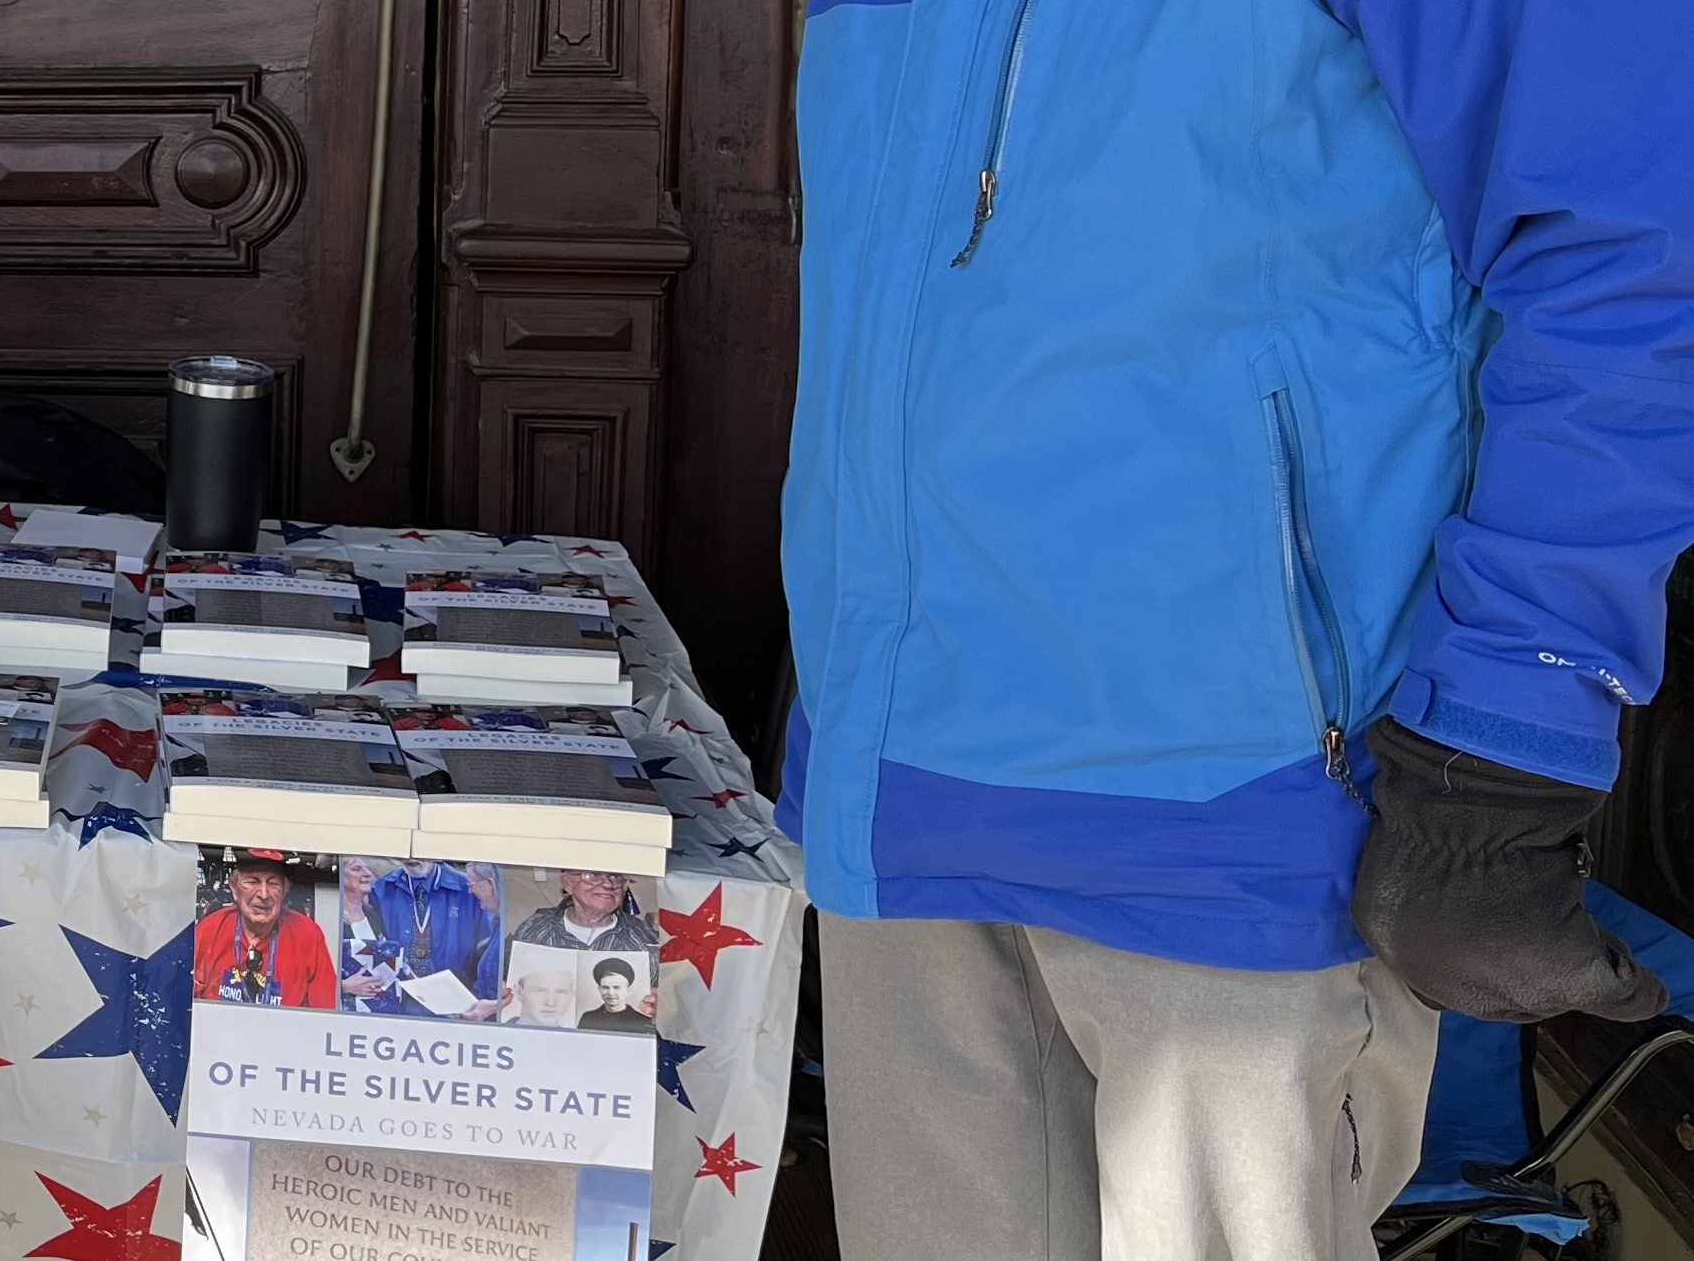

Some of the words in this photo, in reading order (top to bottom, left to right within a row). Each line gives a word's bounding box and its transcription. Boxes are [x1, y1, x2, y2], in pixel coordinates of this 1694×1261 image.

[57, 573, 103, 582] STATE
[241, 580, 295, 588] SILVER
[301, 584, 349, 592] STATE
[547, 602, 596, 610] STATE
[254, 724, 317, 732] SILVER
[325, 728, 380, 737] STATE
[491, 739, 555, 747] SILVER
[563, 742, 620, 750] STATE
[218, 985, 243, 1002] HONO
[325, 1032, 515, 1071] LEGACIES
[209, 1061, 257, 1088] OF
[276, 1067, 346, 1096] THE
[365, 1074, 496, 1109] SILVER
[516, 1087, 632, 1119] STATE
[251, 1106, 363, 1134] NEVADA
[380, 1118, 453, 1142] GOES
[466, 1125, 504, 1144] TO
[518, 1129, 577, 1150] WAR
[325, 1154, 375, 1182] OUR
[383, 1164, 438, 1191] DEBT
[444, 1178, 470, 1199] TO
[476, 1186, 513, 1207] THE
[271, 1173, 361, 1206] HEROIC
[369, 1192, 417, 1215] MEN
[424, 1203, 468, 1224] AND
[474, 1211, 551, 1239] VALIANT
[285, 1205, 379, 1235] WOMEN
[388, 1223, 410, 1240] IN
[417, 1228, 457, 1249] THE
[463, 1236, 538, 1260] SERVICE
[290, 1237, 322, 1256] OF
[330, 1243, 379, 1261] OUR
